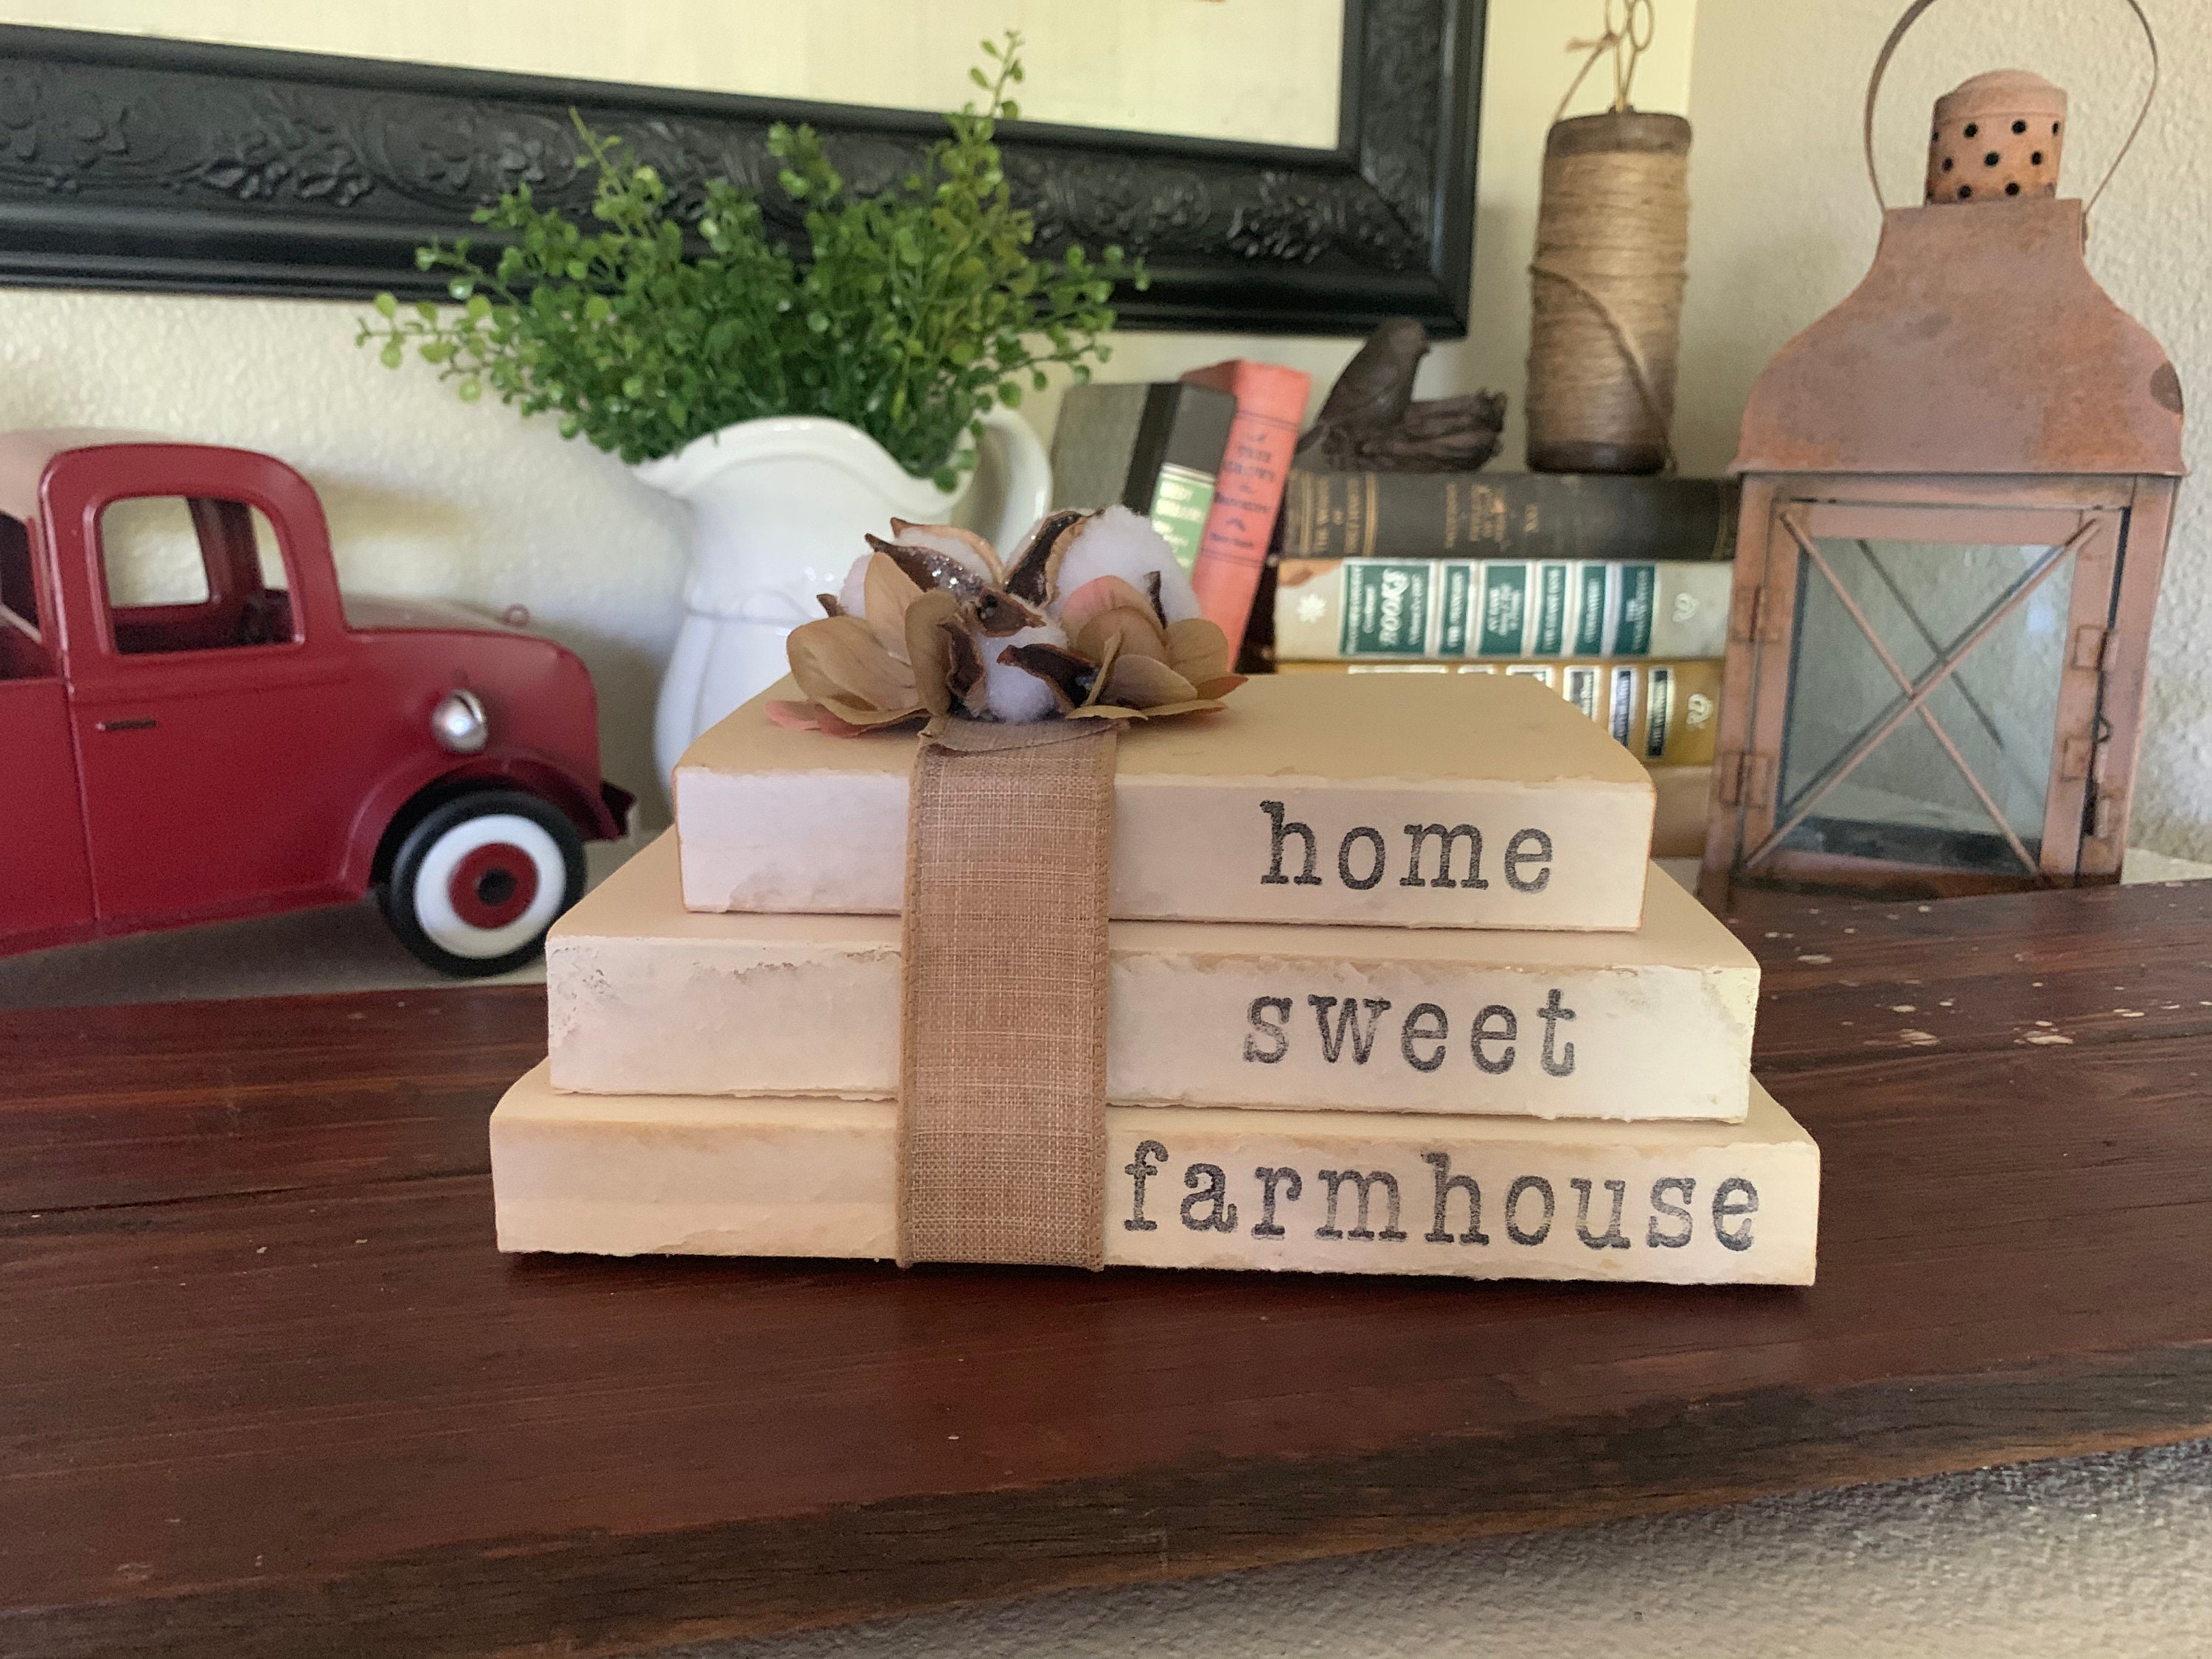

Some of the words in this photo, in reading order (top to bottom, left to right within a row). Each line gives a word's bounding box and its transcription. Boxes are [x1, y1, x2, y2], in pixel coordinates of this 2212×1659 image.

[1379, 568, 1410, 647] BOOKS
[1260, 800, 1553, 892] home
[1243, 989, 1576, 1077] sweet
[1124, 1139, 1760, 1251] farmhouse
